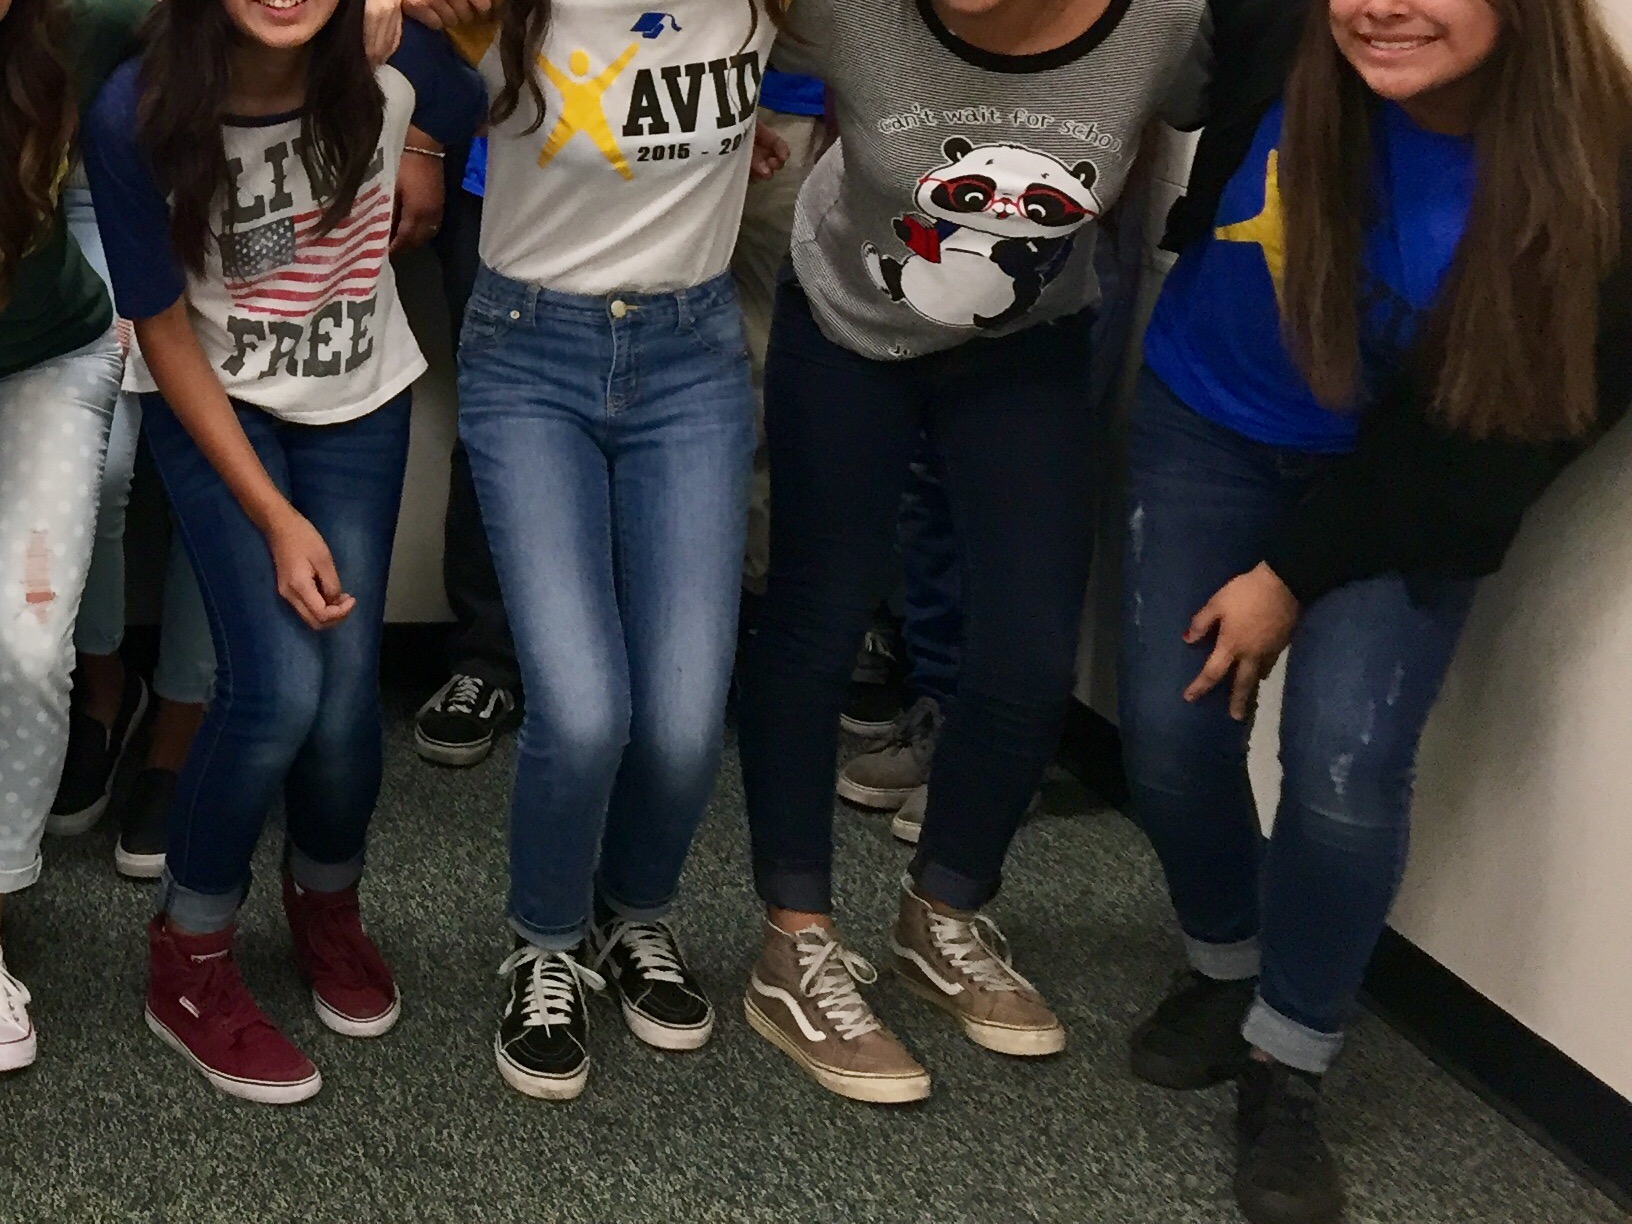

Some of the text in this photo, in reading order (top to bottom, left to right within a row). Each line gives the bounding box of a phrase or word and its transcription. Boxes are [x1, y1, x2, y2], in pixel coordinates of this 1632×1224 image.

[622, 50, 762, 137] AVID
[877, 102, 936, 135] can't
[942, 105, 1002, 125] wait
[1011, 107, 1056, 130] for
[636, 142, 691, 162] 2015
[221, 291, 378, 378] FREE
